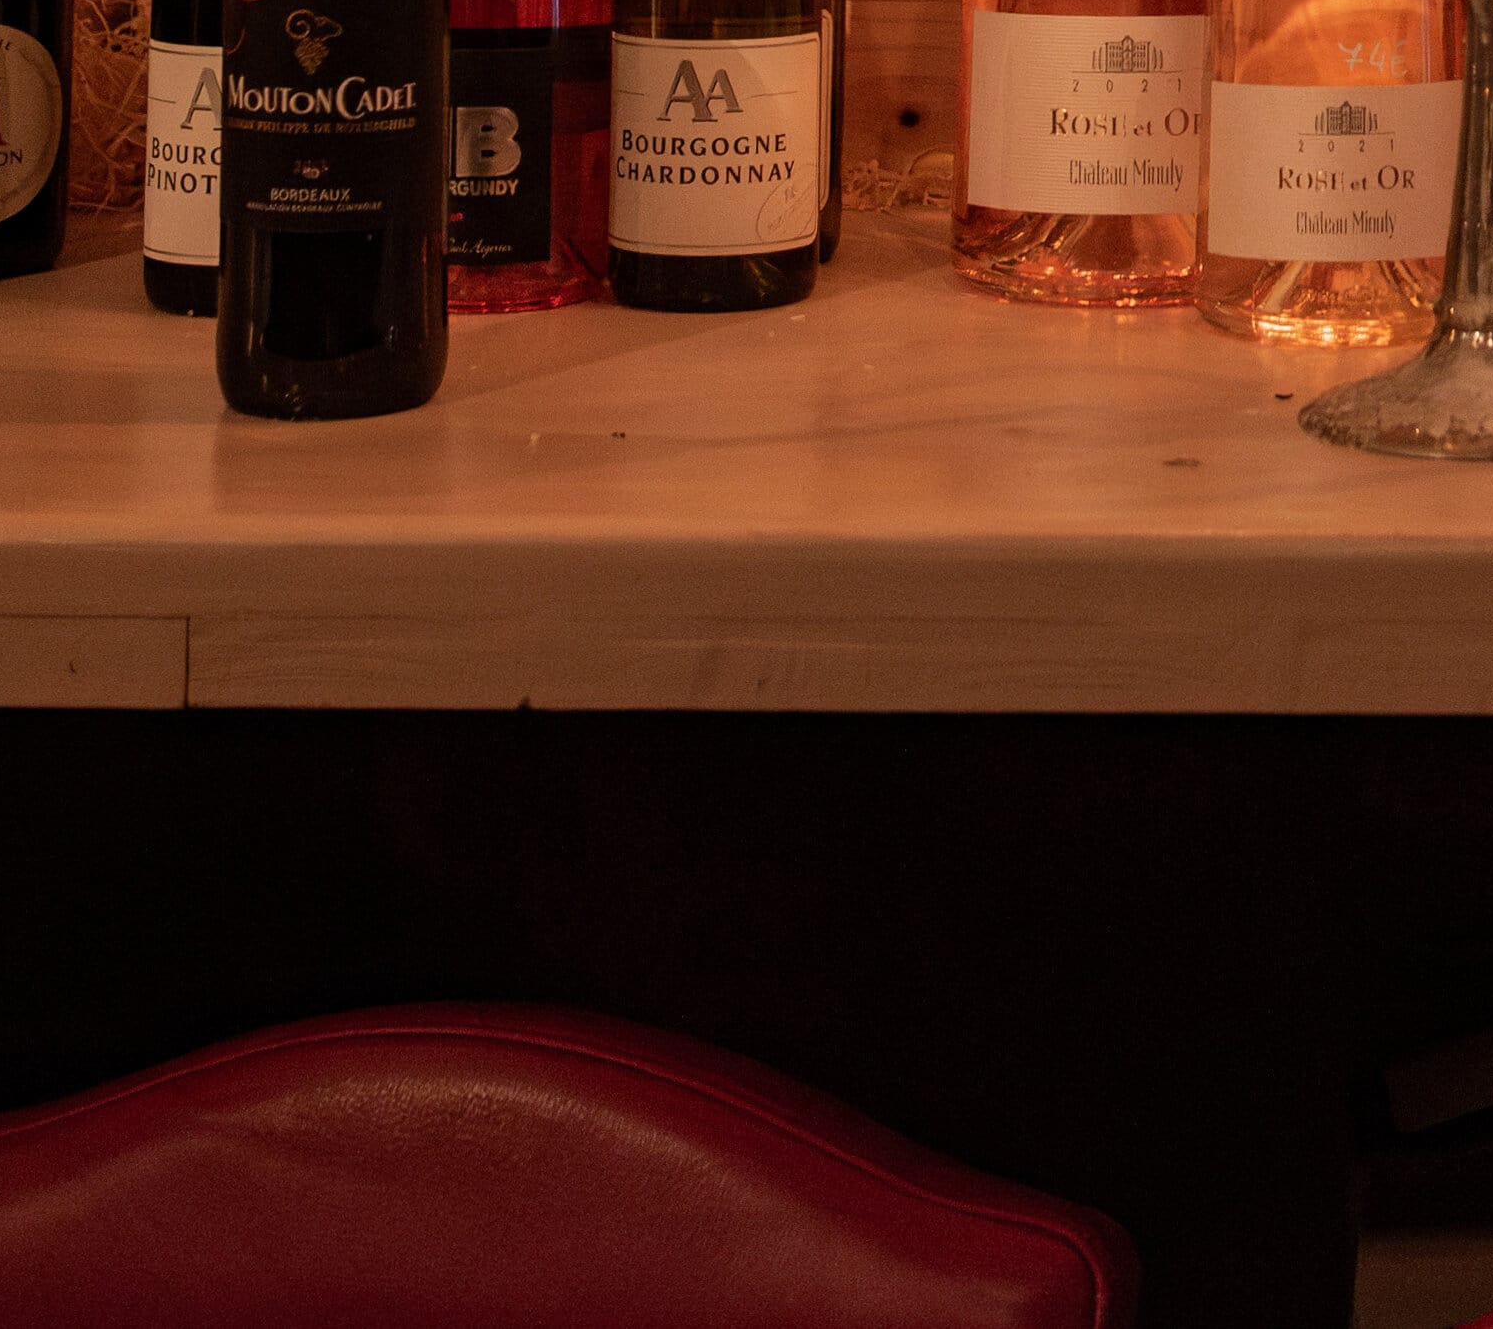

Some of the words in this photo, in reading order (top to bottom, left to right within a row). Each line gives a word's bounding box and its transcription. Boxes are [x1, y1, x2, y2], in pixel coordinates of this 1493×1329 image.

[227, 72, 334, 115] MOUTON
[335, 75, 418, 121] CADET
[656, 59, 743, 123] AA
[1072, 78, 1182, 94] 2021
[455, 105, 523, 179] B
[621, 128, 787, 158] BOURGOGNE
[1132, 119, 1154, 137] et
[1297, 139, 1396, 153] 2021
[146, 163, 218, 195] PINOT
[616, 155, 796, 186] CHARDONNAY
[1349, 176, 1369, 192] et
[1376, 163, 1417, 191] OR
[269, 187, 352, 203] BORDEAUX
